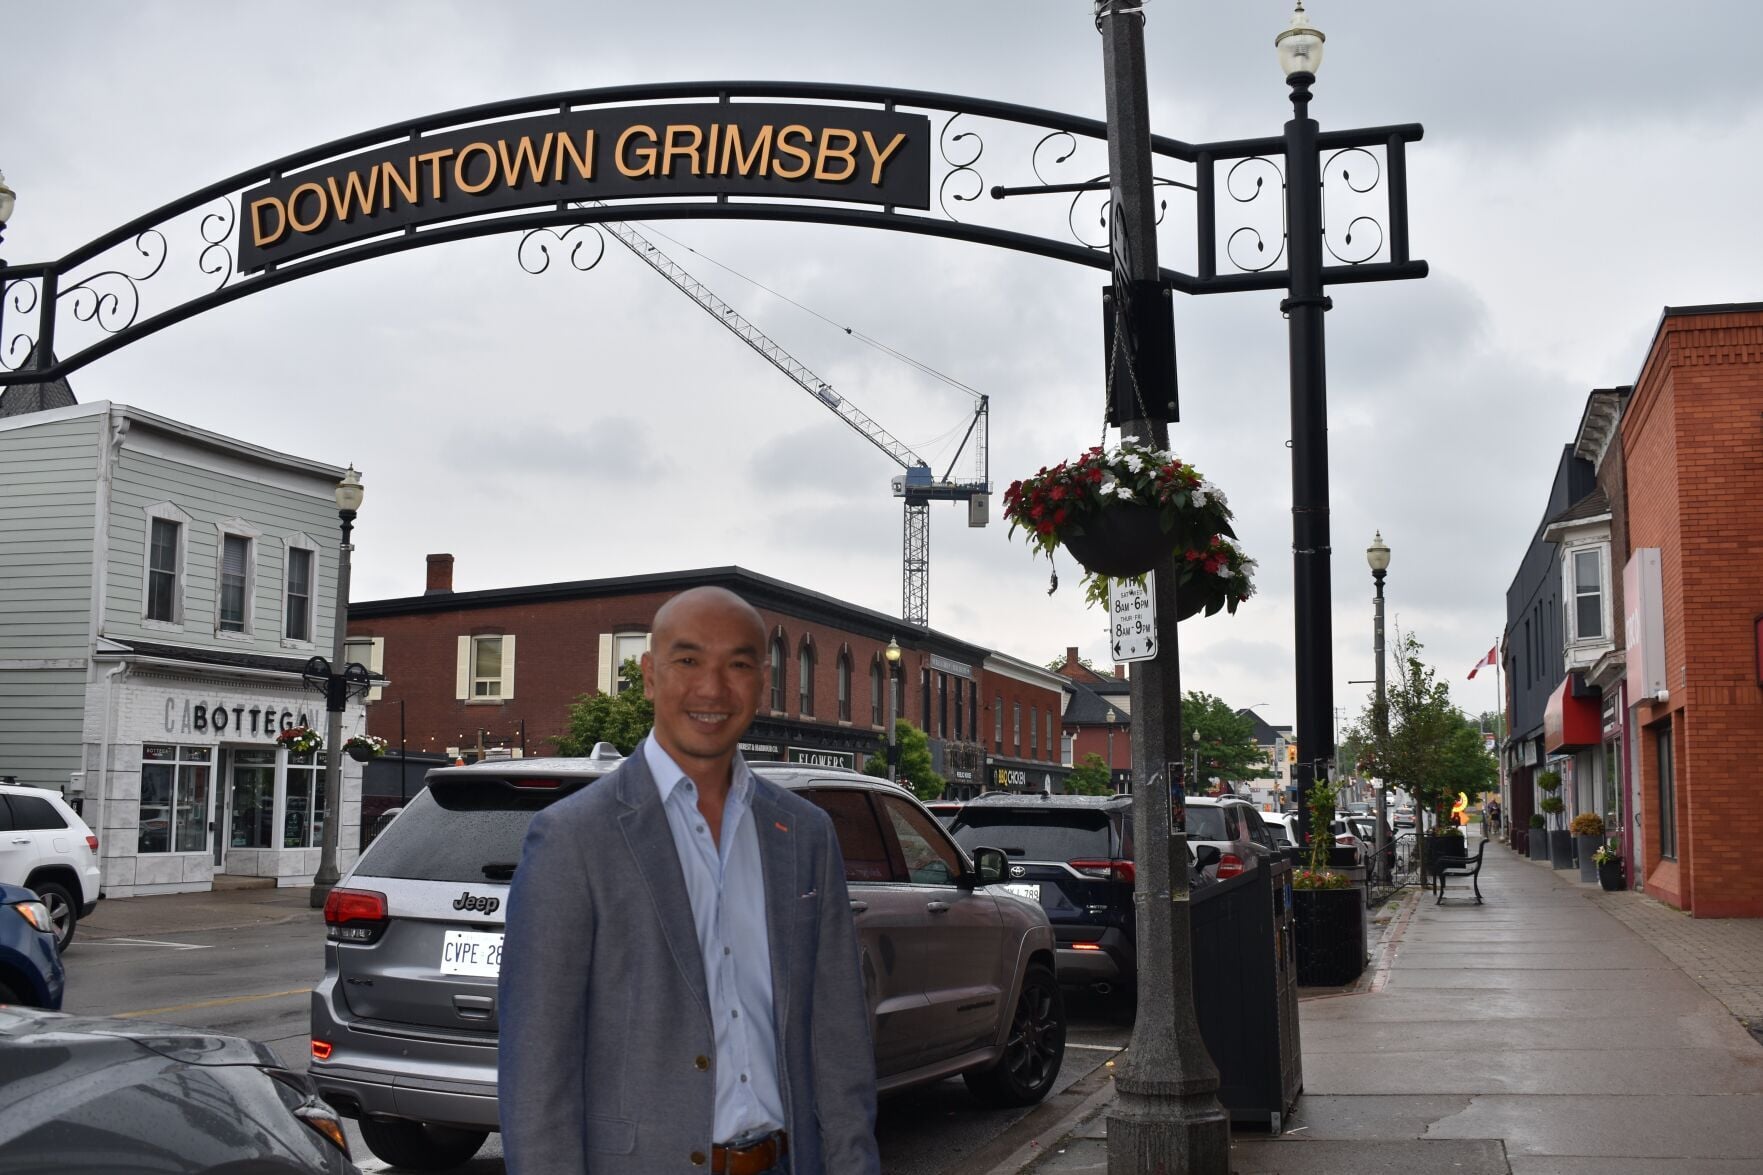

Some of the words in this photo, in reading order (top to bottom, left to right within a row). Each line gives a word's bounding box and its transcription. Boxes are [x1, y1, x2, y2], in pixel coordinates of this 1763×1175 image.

[249, 128, 595, 248] DOWNTOWN
[614, 123, 906, 186] GRIMSBY
[1115, 599, 1130, 613] 8AM
[1134, 596, 1148, 610] 6PM
[1116, 624, 1130, 637] 8AM
[1135, 621, 1150, 634] 9PM
[193, 704, 309, 733] BOTTEGA
[798, 753, 845, 769] FLOWERS
[998, 768, 1008, 786] BBQ
[1007, 769, 1026, 785] CHICKEN
[453, 892, 500, 916] Jeep
[444, 942, 480, 964] CVPE
